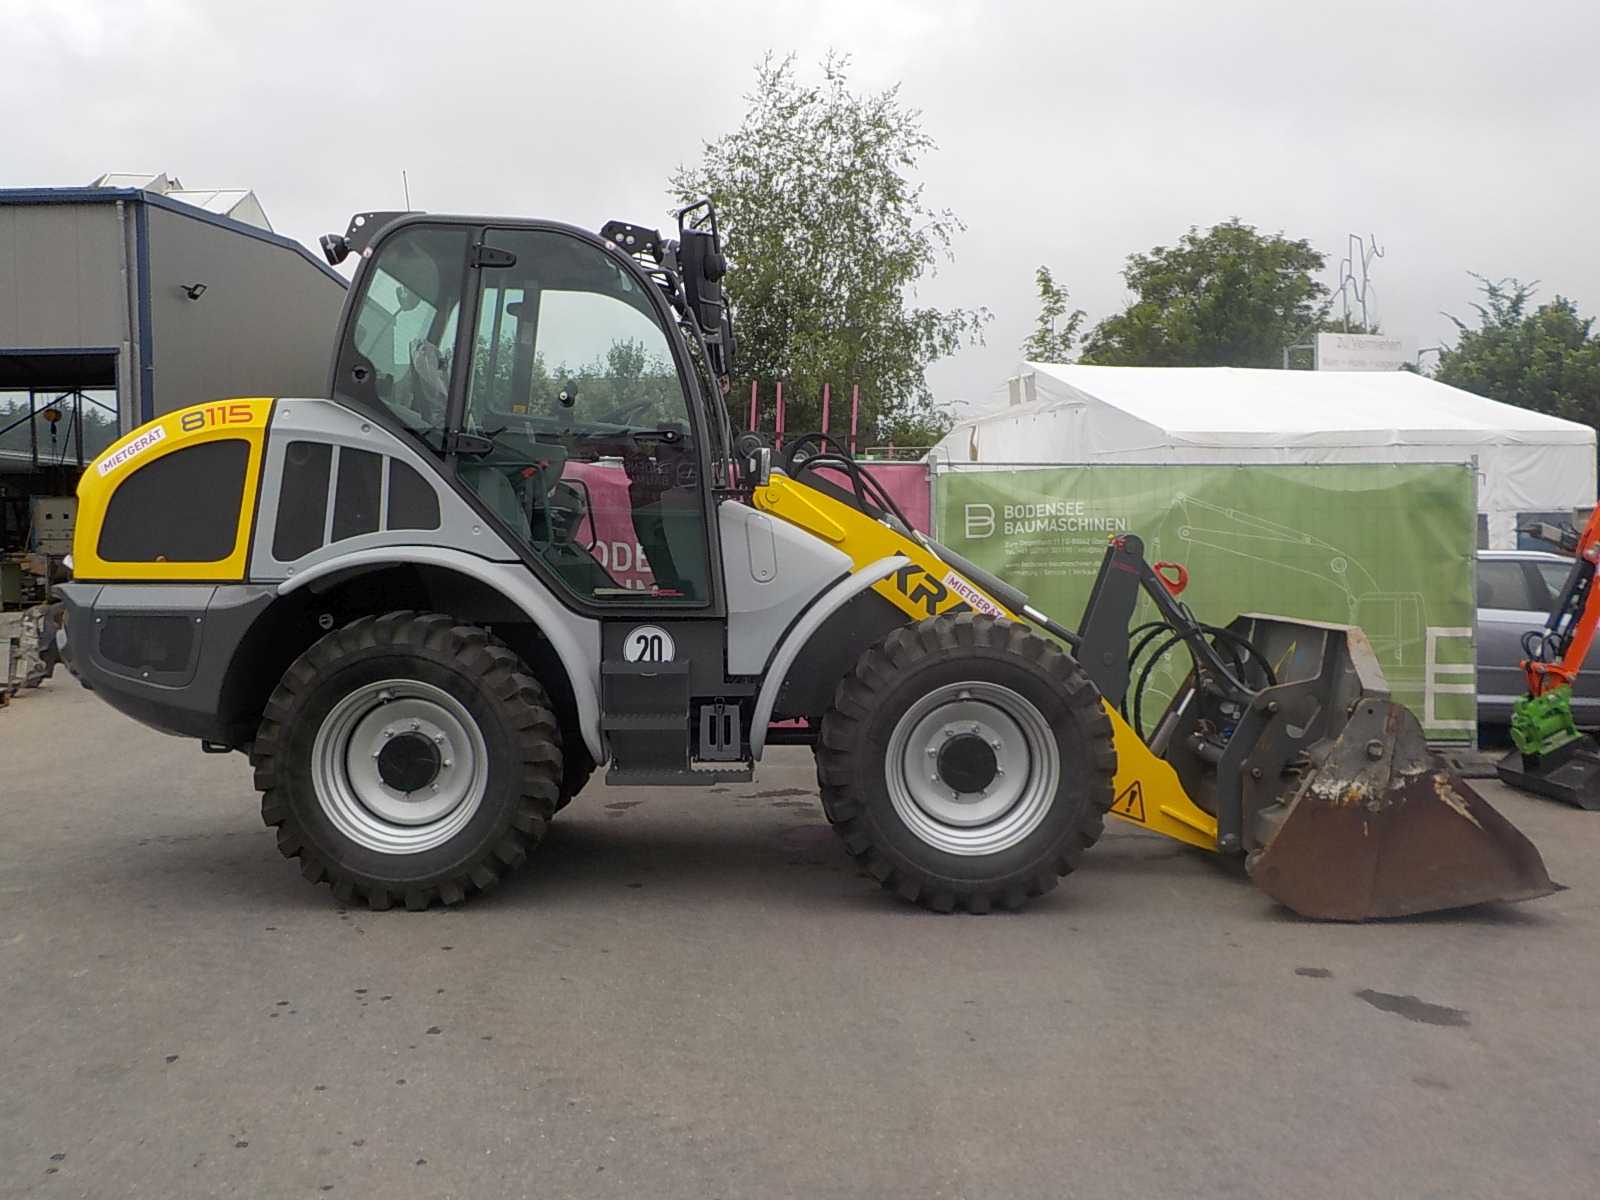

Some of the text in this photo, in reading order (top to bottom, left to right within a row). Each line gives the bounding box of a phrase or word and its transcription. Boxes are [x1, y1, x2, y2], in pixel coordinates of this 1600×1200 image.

[181, 404, 254, 432] 8115
[103, 428, 162, 472] MIETGERÄT
[1003, 502, 1085, 519] BODENSEE
[1003, 517, 1127, 535] BAUMASCHINEN
[883, 550, 973, 616] KR
[635, 634, 663, 662] 20
